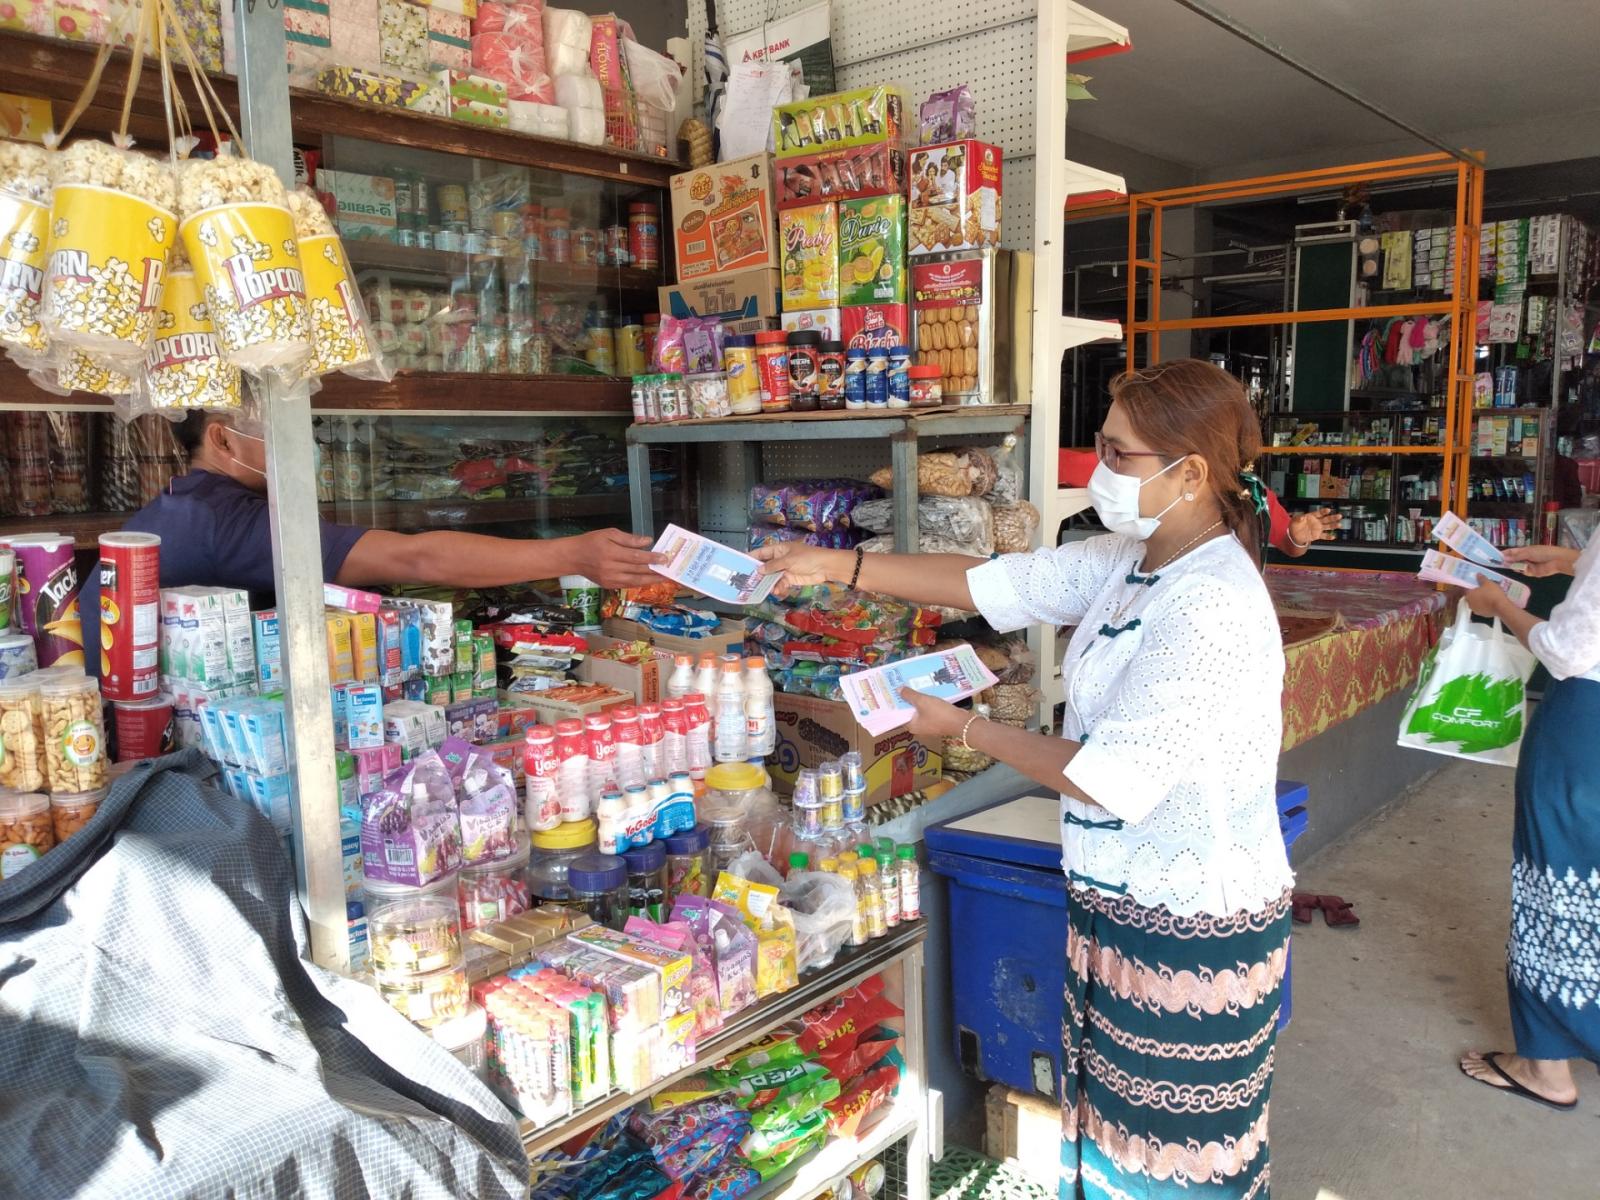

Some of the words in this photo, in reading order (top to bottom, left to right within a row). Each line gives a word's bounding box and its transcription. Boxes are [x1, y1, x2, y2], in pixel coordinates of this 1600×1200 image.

[769, 39, 790, 54] BANK
[1453, 707, 1482, 718] CF
[1431, 712, 1501, 729] COMFORT
